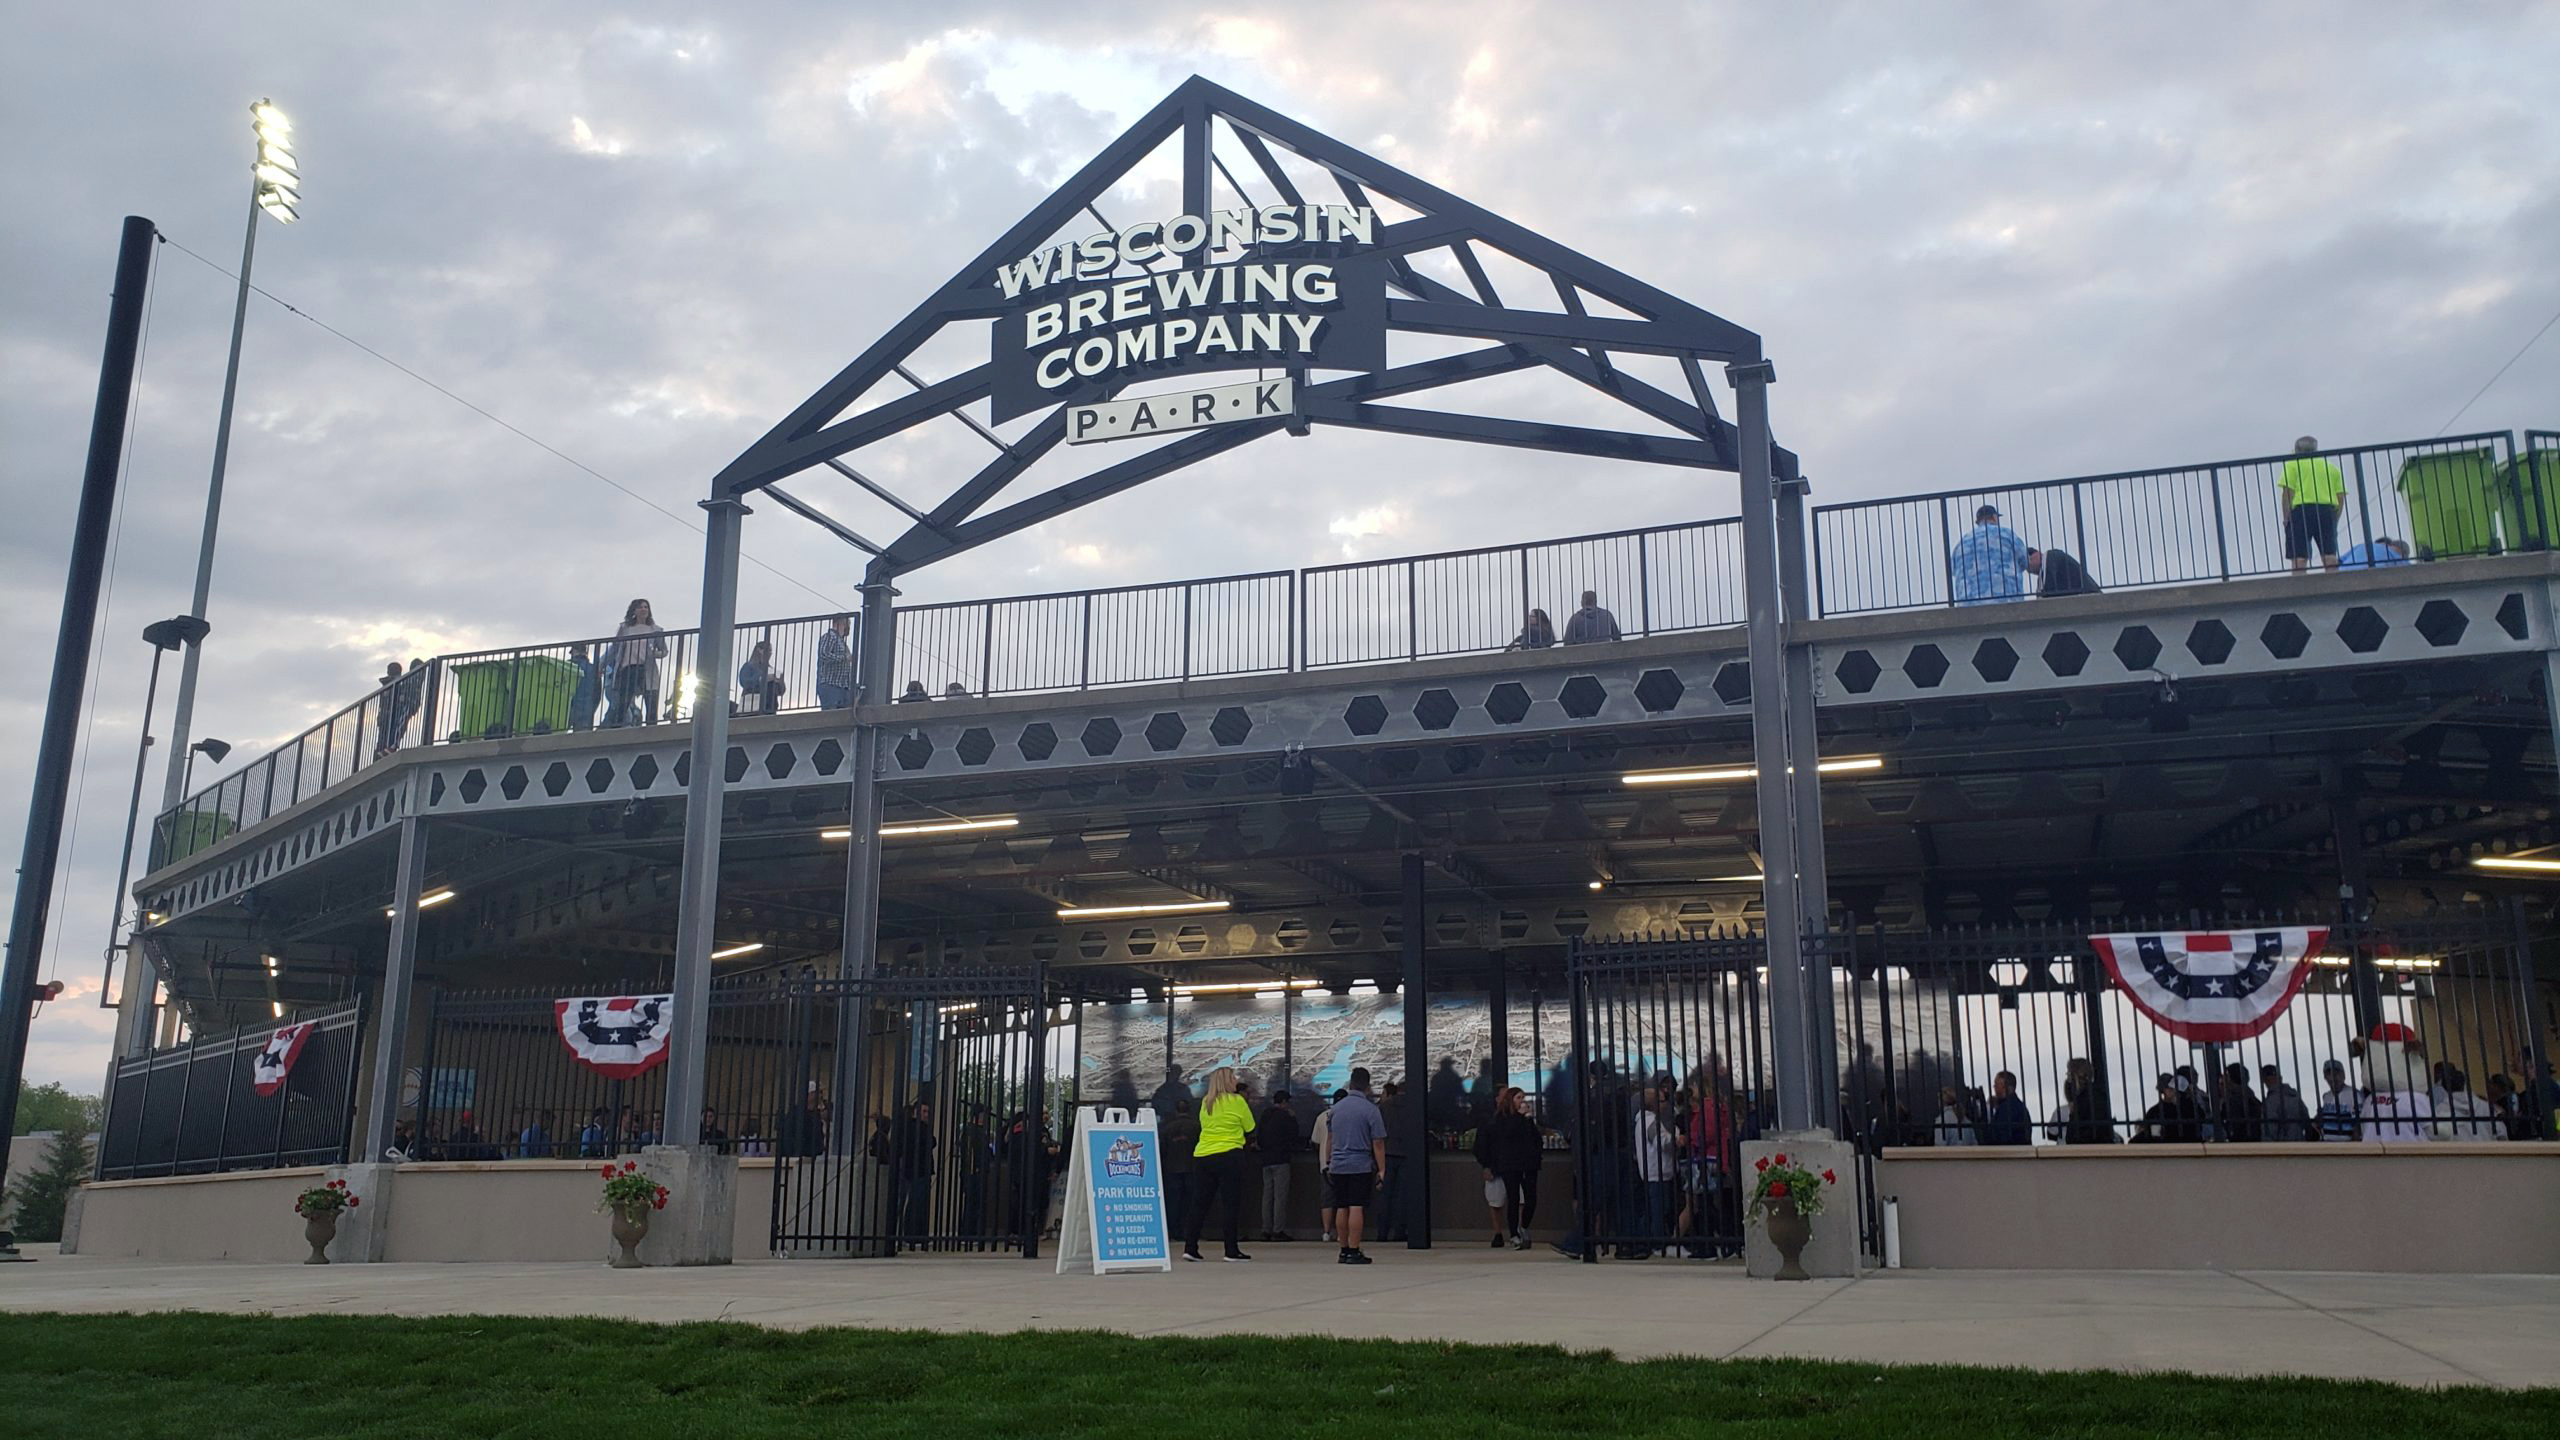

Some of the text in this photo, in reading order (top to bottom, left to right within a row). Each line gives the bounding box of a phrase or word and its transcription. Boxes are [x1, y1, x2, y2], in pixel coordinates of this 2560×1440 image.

[997, 204, 1373, 300] WISCONSIN
[1025, 264, 1338, 349] BREWING
[1036, 313, 1325, 389] COMPANY
[1098, 1187, 1155, 1198] PARK RULES
[1125, 1214, 1153, 1222] PEANUTS
[1126, 1225, 1145, 1233] SEEDS
[1127, 1236, 1157, 1245] RE-ENTRY
[1118, 1247, 1158, 1256] NO WEAPONS
